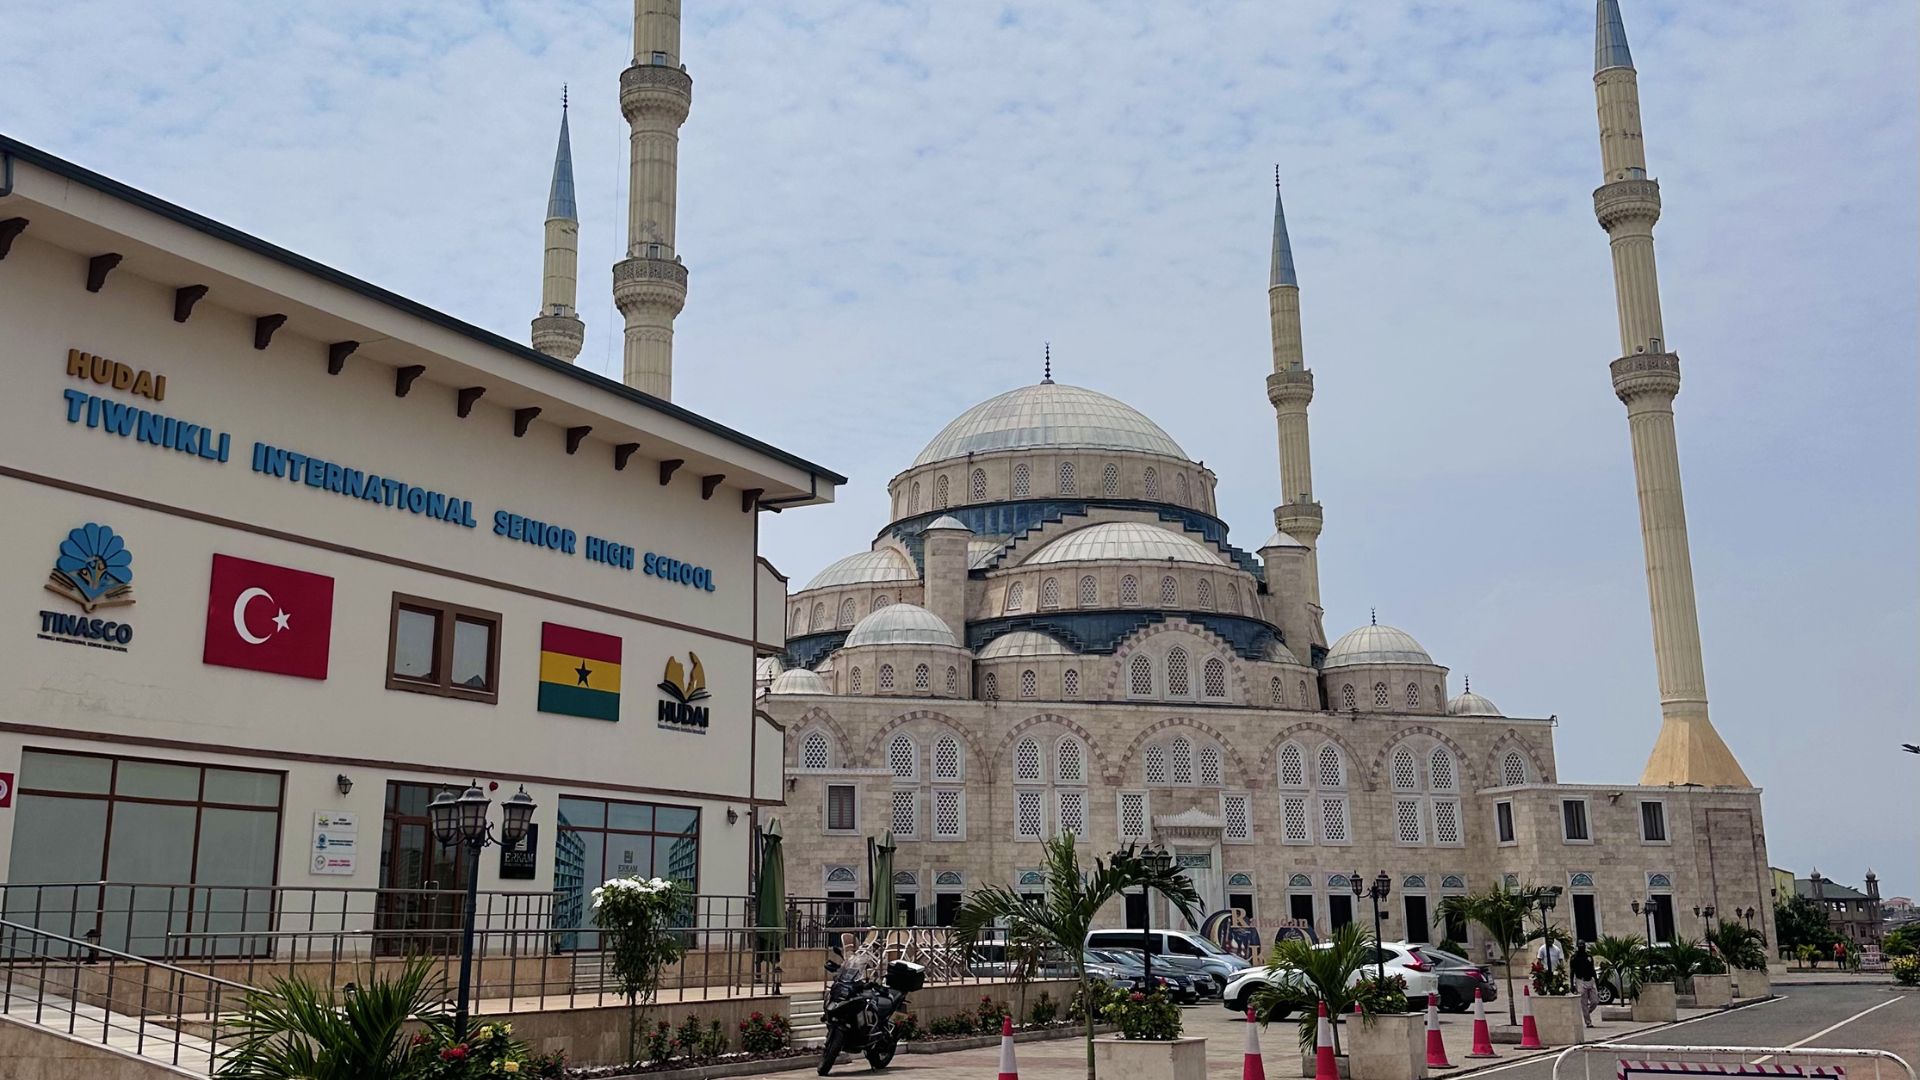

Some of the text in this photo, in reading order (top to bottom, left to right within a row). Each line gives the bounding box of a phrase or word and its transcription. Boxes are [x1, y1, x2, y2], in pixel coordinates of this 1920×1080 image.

[66, 349, 167, 401] HUDAI
[64, 388, 716, 592] TIWNIKLI INTERNATIONAL SENIOR HIGH SCHOOL
[39, 610, 133, 644] TINASCO
[658, 699, 710, 728] HUDAI
[505, 852, 534, 863] ERKAM
[1230, 907, 1309, 928] Ramadan
